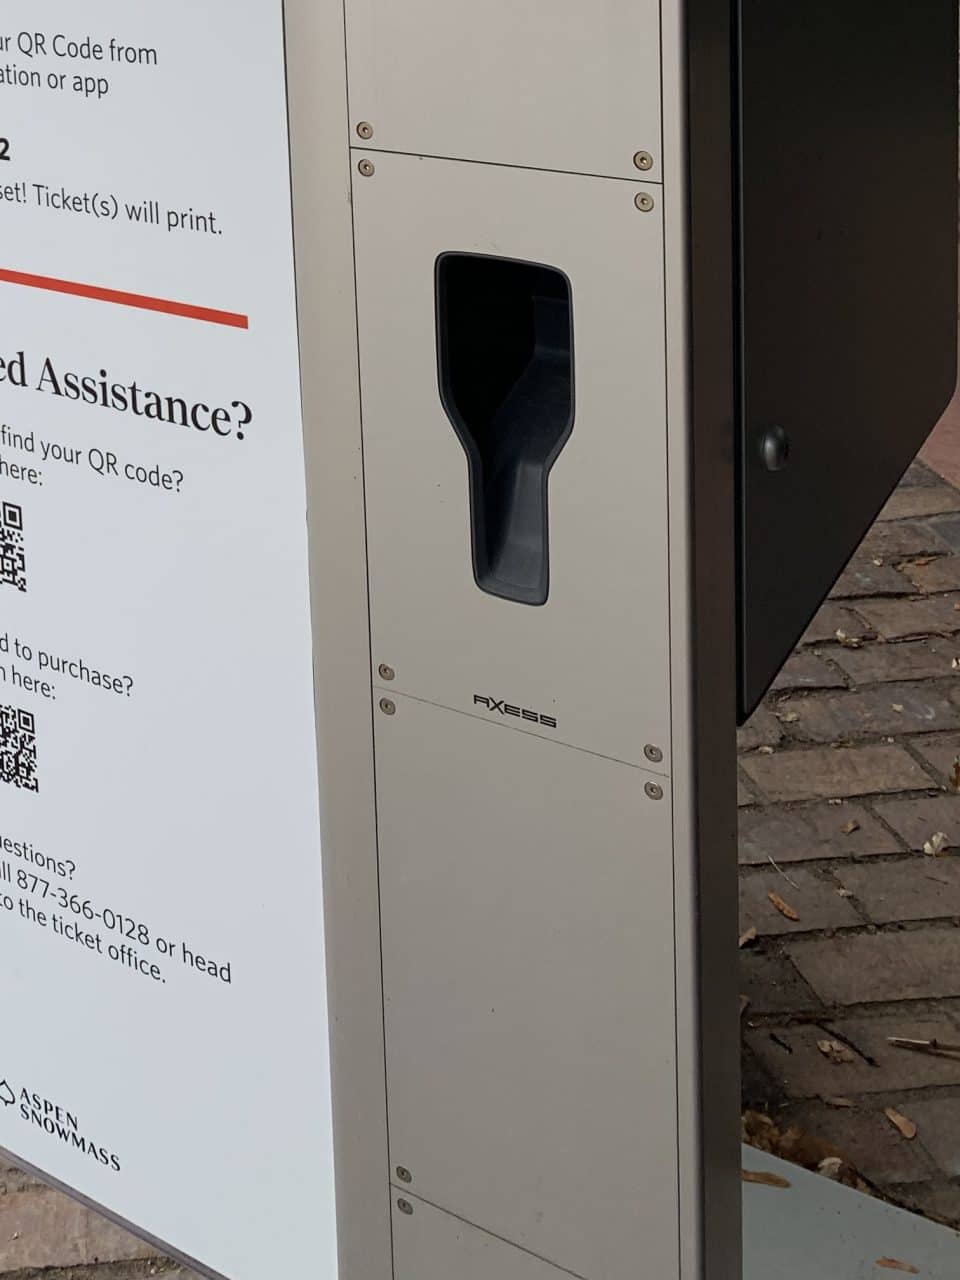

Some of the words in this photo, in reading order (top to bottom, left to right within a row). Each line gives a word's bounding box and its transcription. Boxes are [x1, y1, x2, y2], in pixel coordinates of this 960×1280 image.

[17, 30, 46, 58] QR
[52, 34, 103, 60] Code
[109, 38, 158, 65] from
[47, 73, 66, 90] or
[72, 75, 109, 99] app
[32, 184, 119, 220] Ticket(s)
[125, 200, 159, 225] will
[166, 208, 223, 235] print.
[35, 356, 252, 440] Assistance?
[1, 424, 34, 453] find
[40, 439, 82, 465] your
[88, 448, 119, 476] QR
[124, 462, 184, 493] code?
[12, 665, 56, 700] here:
[14, 638, 32, 661] to
[38, 650, 134, 697] purchase?
[473, 694, 557, 729] AXESS
[16, 869, 150, 947] 877-366-0128
[156, 934, 176, 959] or
[182, 941, 232, 984] head
[18, 896, 48, 927] the
[52, 914, 103, 953] ticket
[107, 942, 167, 984] office.
[19, 1087, 79, 1131] ASPEN
[20, 1103, 121, 1172] SNOWMASS
